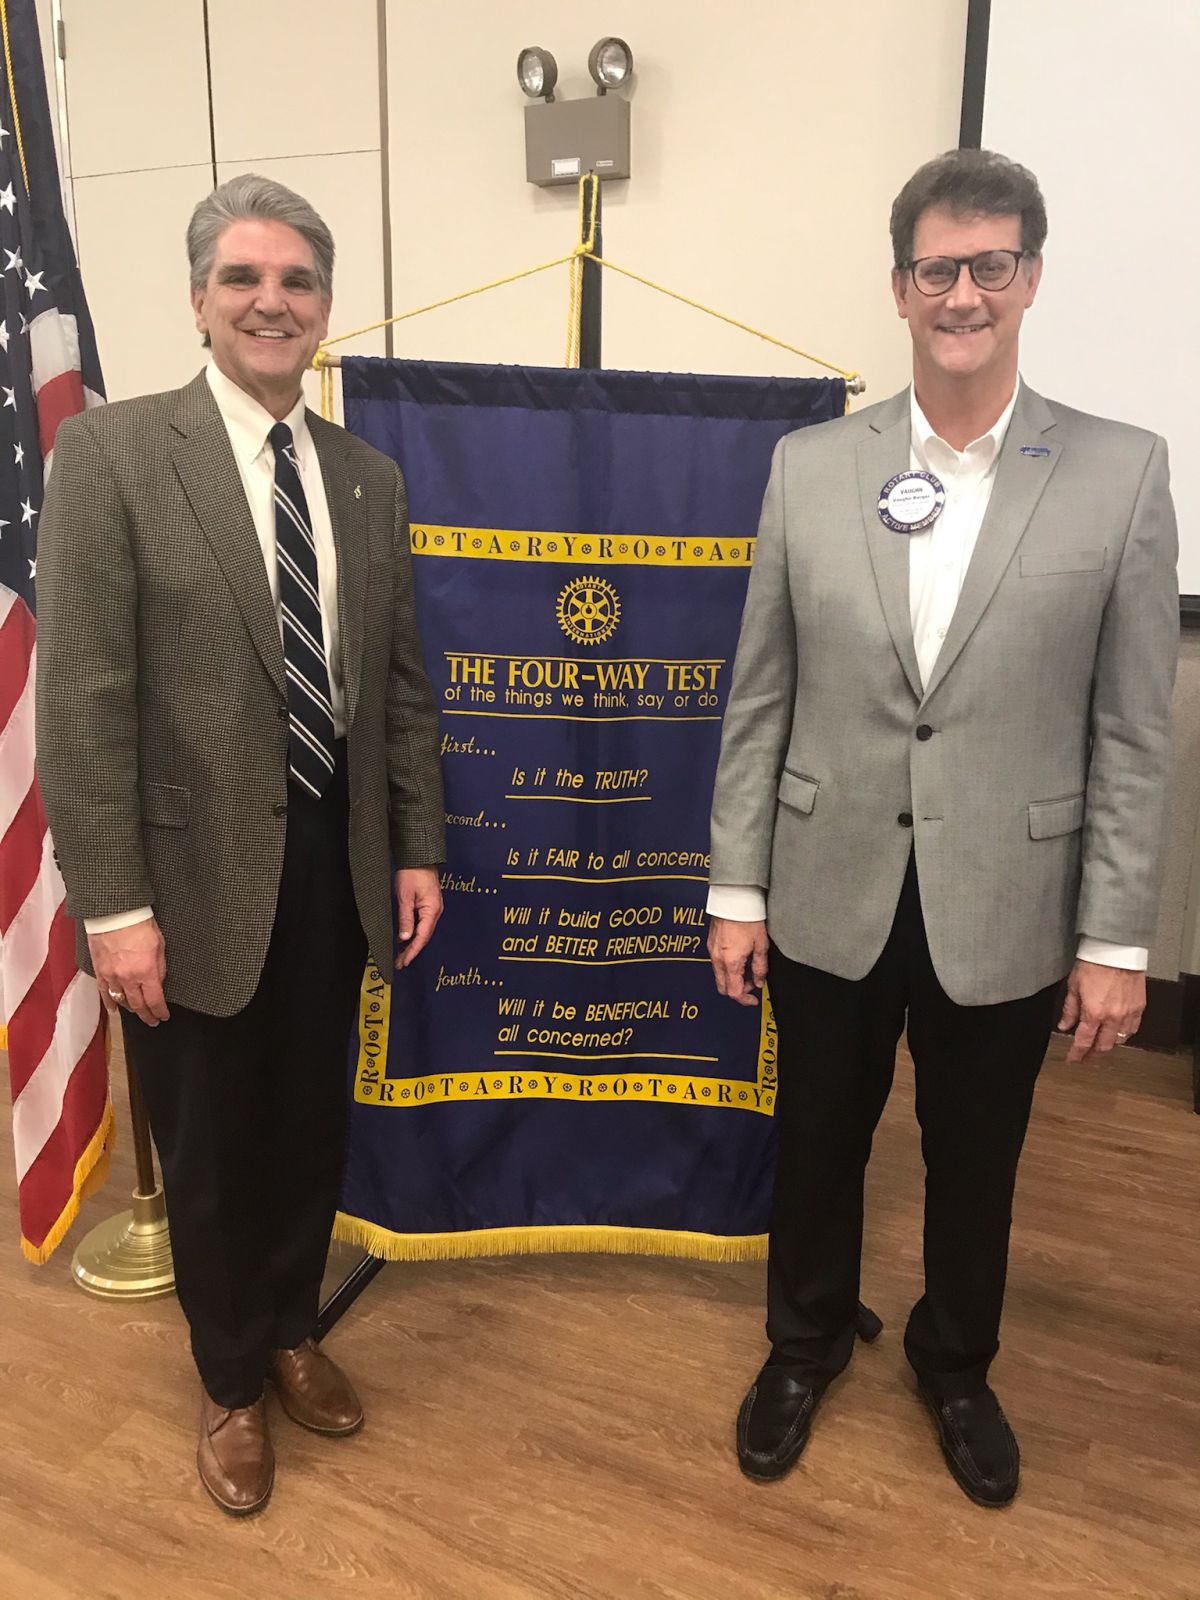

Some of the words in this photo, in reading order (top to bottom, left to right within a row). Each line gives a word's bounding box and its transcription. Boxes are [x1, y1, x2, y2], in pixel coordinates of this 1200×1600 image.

[884, 471, 917, 493] ROTARY
[920, 472, 941, 488] CLUB
[881, 513, 909, 531] ACTIVE
[411, 529, 578, 557] OTARY
[565, 617, 613, 638] INTERNATIONAL
[446, 656, 496, 686] THE
[507, 661, 650, 691] FOUR-WAY
[663, 664, 722, 691] TEST
[444, 685, 462, 701] of
[470, 686, 496, 703] the
[504, 688, 553, 708] things
[561, 693, 584, 707] we
[637, 694, 665, 710] say
[674, 695, 690, 708] or
[698, 691, 719, 707] do
[511, 767, 526, 786] Is
[533, 767, 547, 786] it
[555, 768, 584, 789] the
[595, 768, 649, 790] TRUTH?
[506, 847, 520, 866] Is
[527, 848, 539, 866] it
[545, 848, 580, 869] FAIR
[587, 851, 605, 871] to
[612, 850, 631, 869] all
[636, 849, 711, 869] concerne
[504, 906, 532, 925] Will
[538, 907, 551, 925] it
[557, 908, 602, 929] build
[609, 906, 663, 928] GOOD
[672, 906, 706, 927] WILL
[502, 935, 539, 953] and
[545, 934, 599, 957] BETTER
[605, 934, 701, 957] FRIENDSHIP?
[498, 997, 526, 1016] Will
[532, 999, 545, 1017] it
[551, 1001, 577, 1021] be
[584, 1000, 670, 1022] BENEFICIAL
[680, 1001, 699, 1020] to
[498, 1024, 520, 1042] all
[527, 1027, 634, 1048] concerned?
